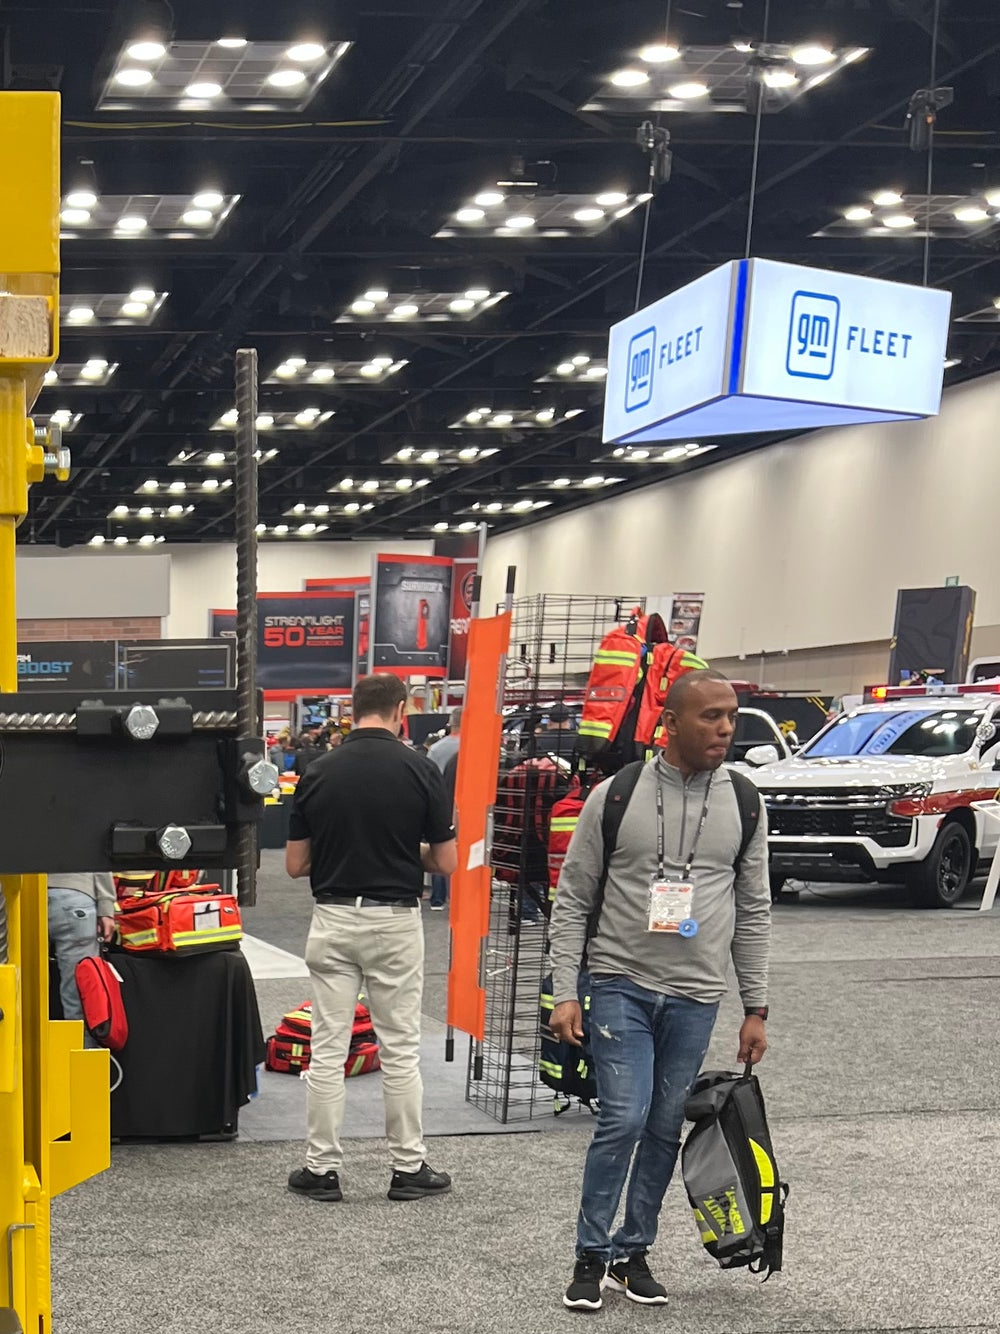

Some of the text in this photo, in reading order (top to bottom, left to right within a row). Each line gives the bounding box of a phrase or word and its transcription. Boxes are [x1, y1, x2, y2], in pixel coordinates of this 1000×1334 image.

[658, 325, 704, 370] FLEET
[847, 325, 913, 359] FLEET
[264, 615, 345, 627] STREAMLIGHT
[263, 626, 305, 647] 50
[307, 626, 344, 636] YEAR
[17, 661, 73, 674] BOOST
